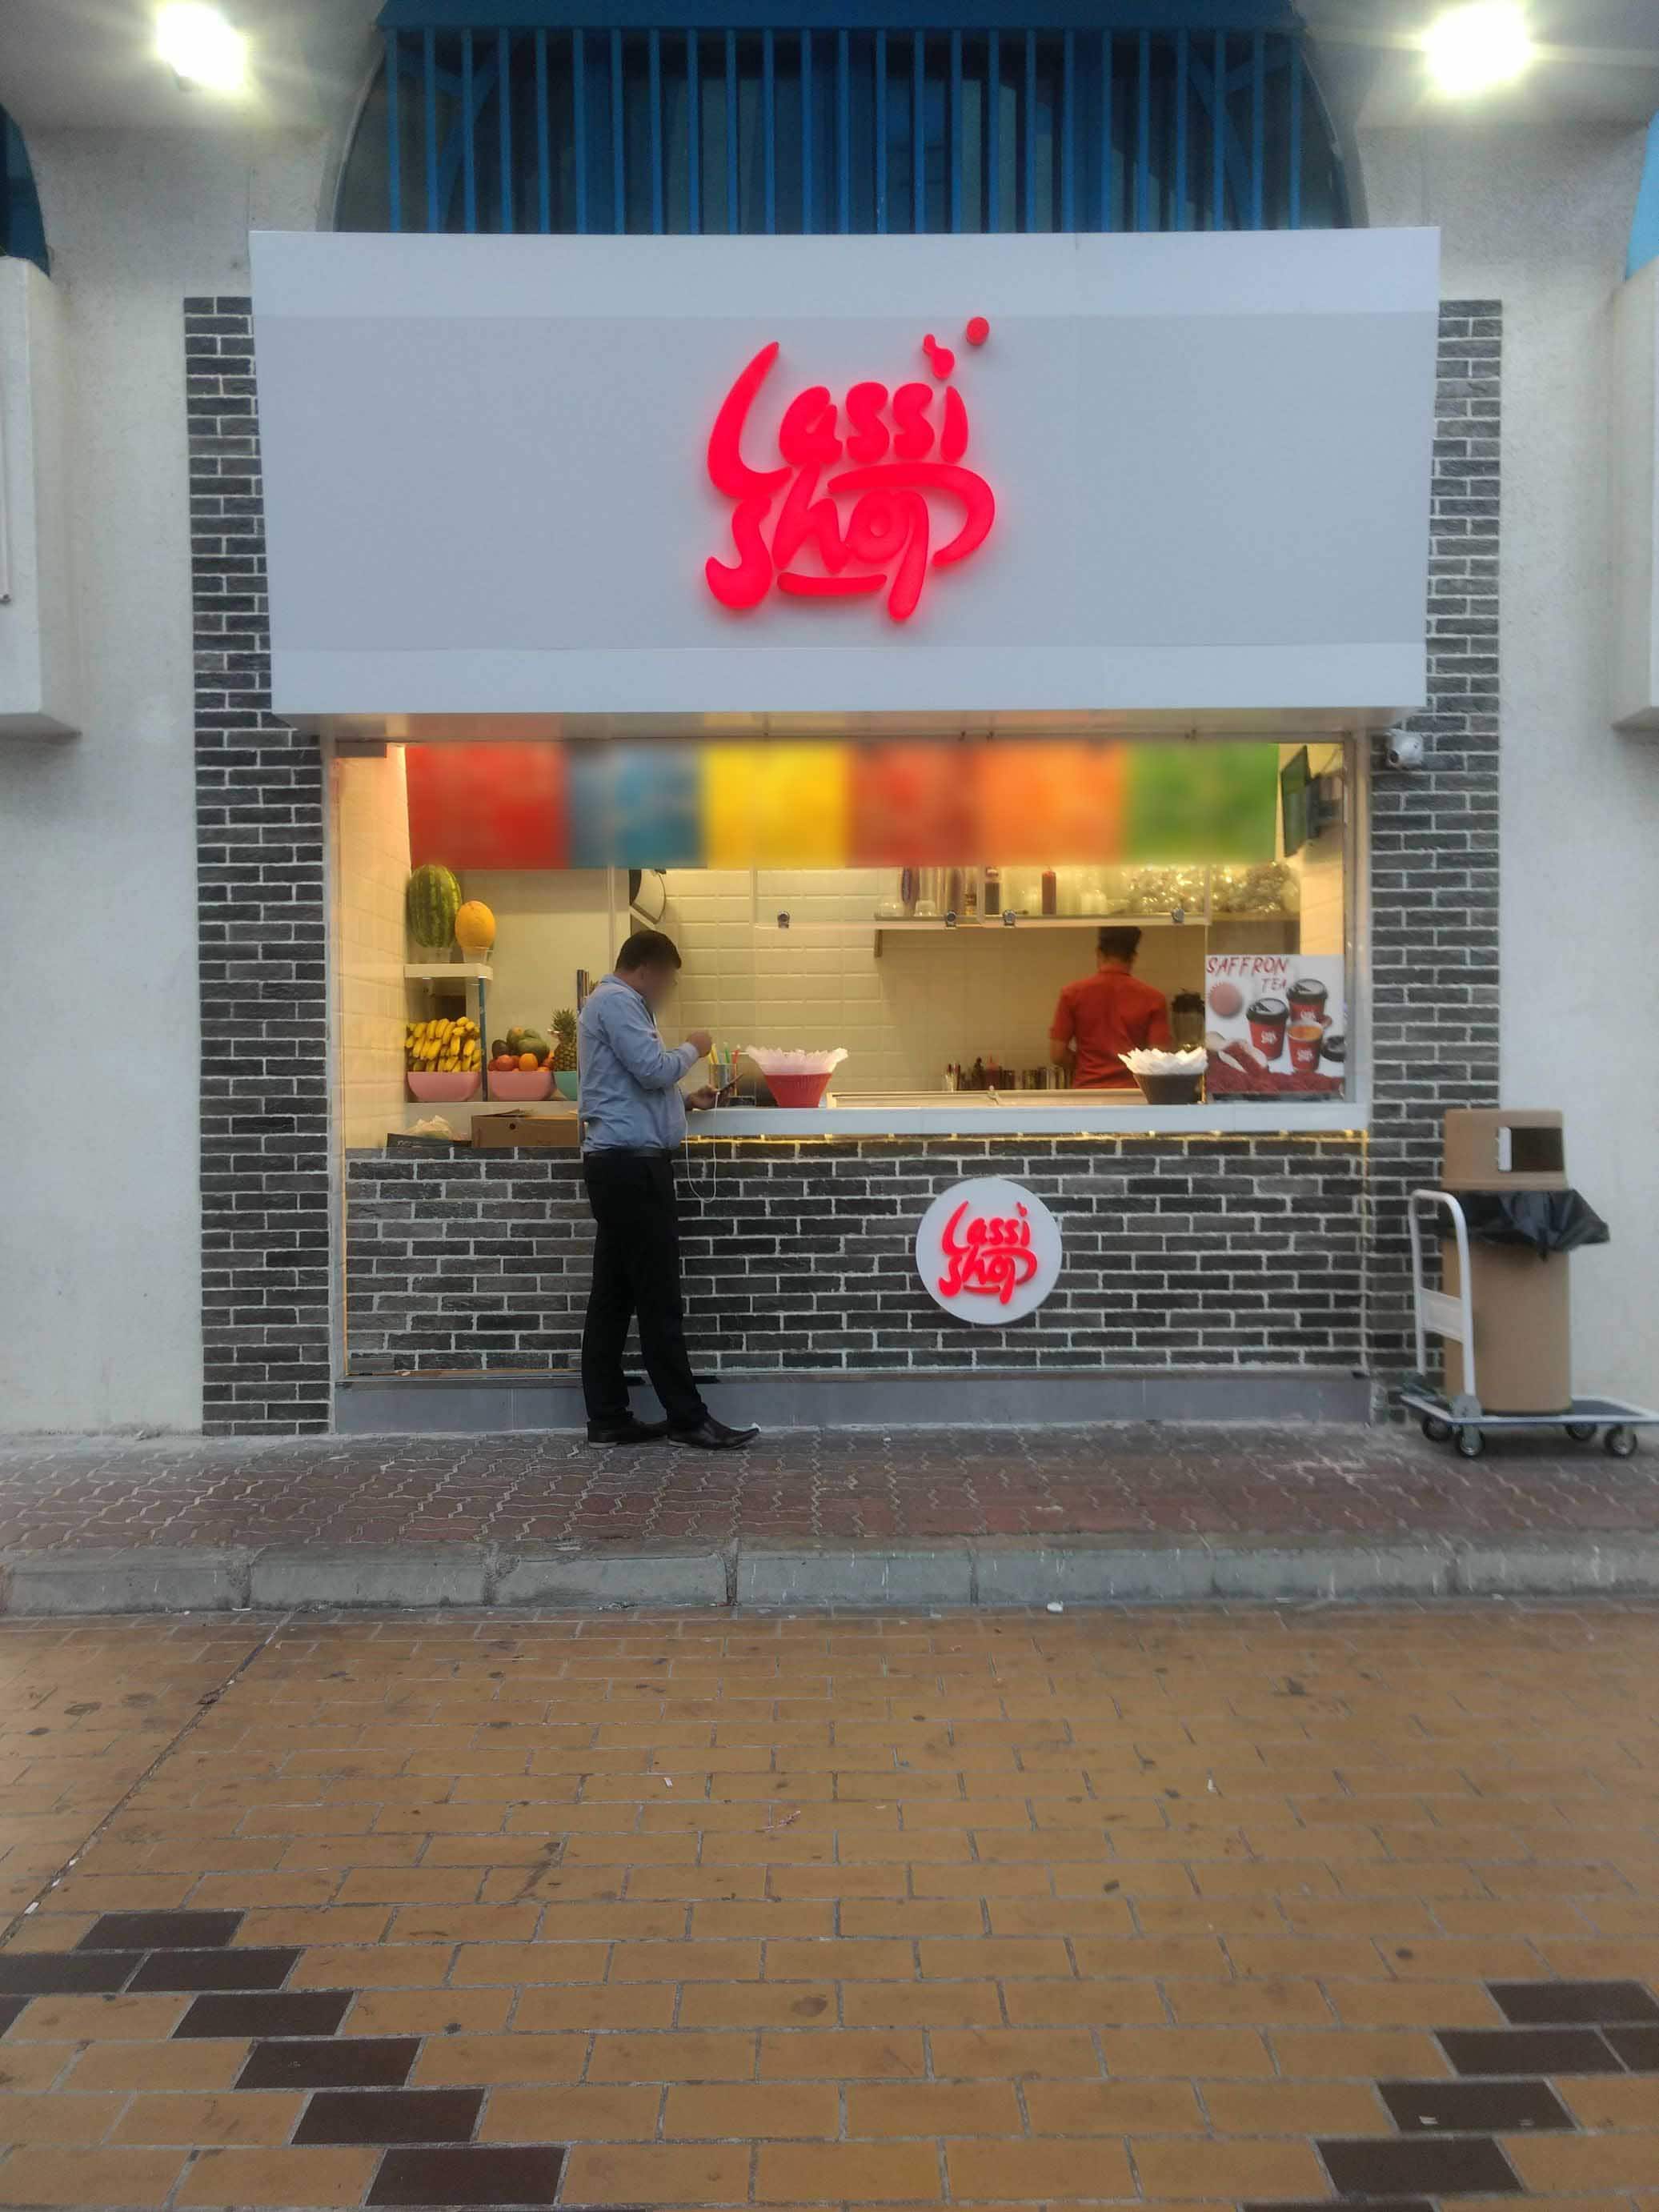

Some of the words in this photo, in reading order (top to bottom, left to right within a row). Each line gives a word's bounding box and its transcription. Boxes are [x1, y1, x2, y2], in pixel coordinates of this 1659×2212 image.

[707, 333, 968, 500] Lassi
[705, 460, 996, 622] Shop
[1206, 956, 1288, 976] SAFFRON
[1261, 978, 1287, 992] TEA
[942, 1200, 1031, 1256] Lassi
[938, 1244, 1037, 1304] Shop
